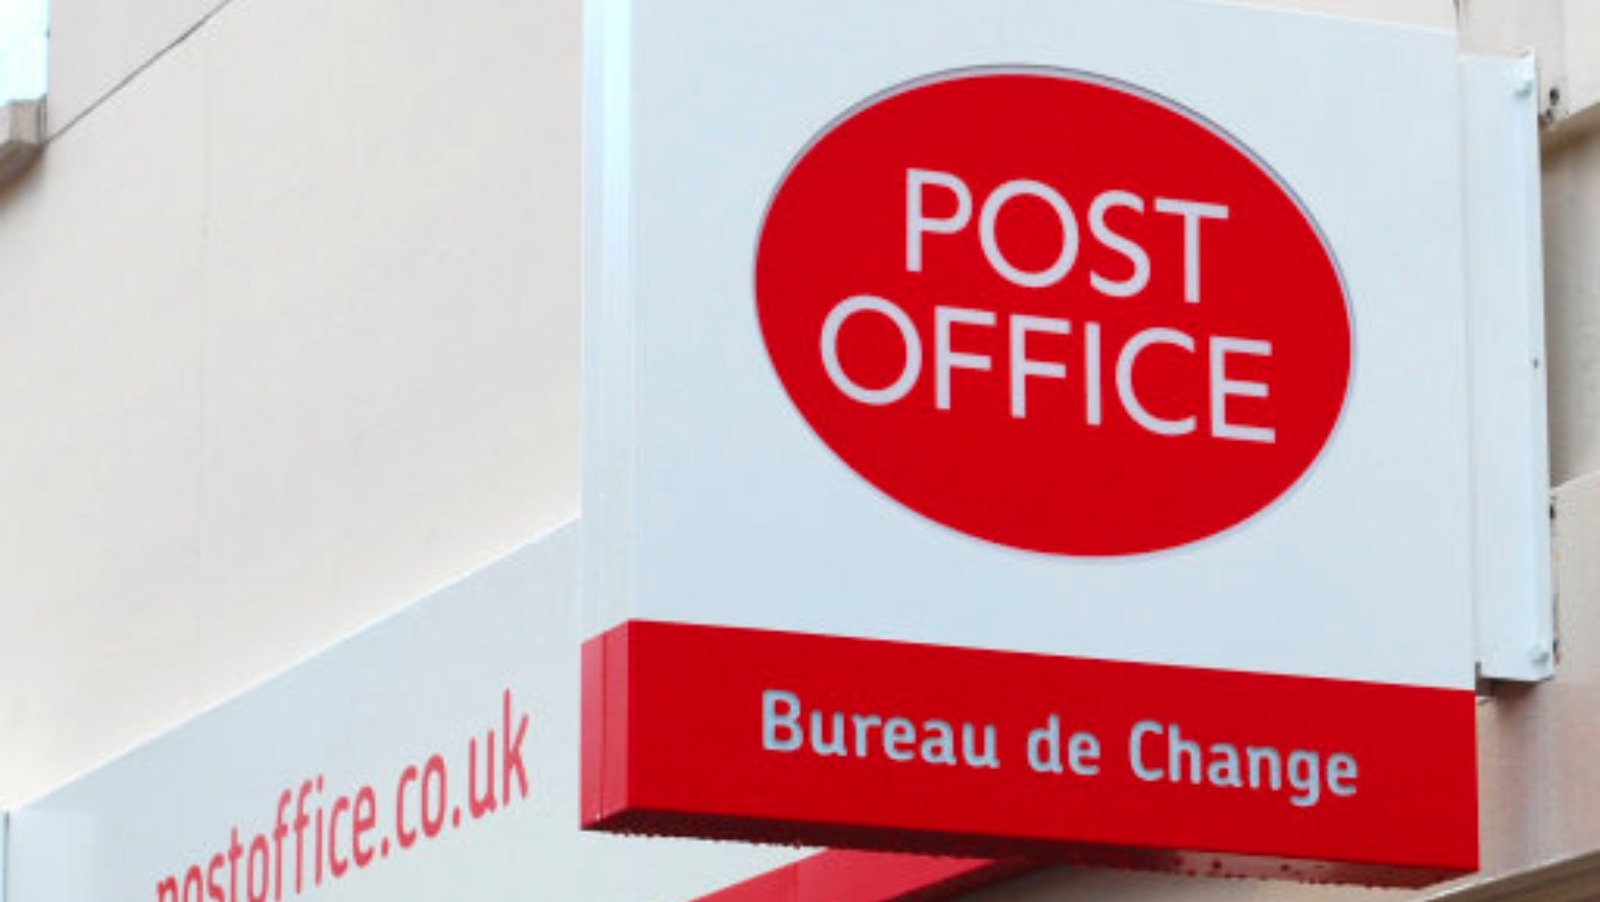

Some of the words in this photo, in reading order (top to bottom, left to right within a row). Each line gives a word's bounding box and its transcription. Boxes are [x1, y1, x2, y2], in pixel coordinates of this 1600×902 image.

[905, 168, 1229, 304] POST
[820, 295, 1276, 443] OFFICE
[762, 690, 1000, 769] Bureau
[1027, 714, 1101, 776] de
[1129, 720, 1359, 807] Change
